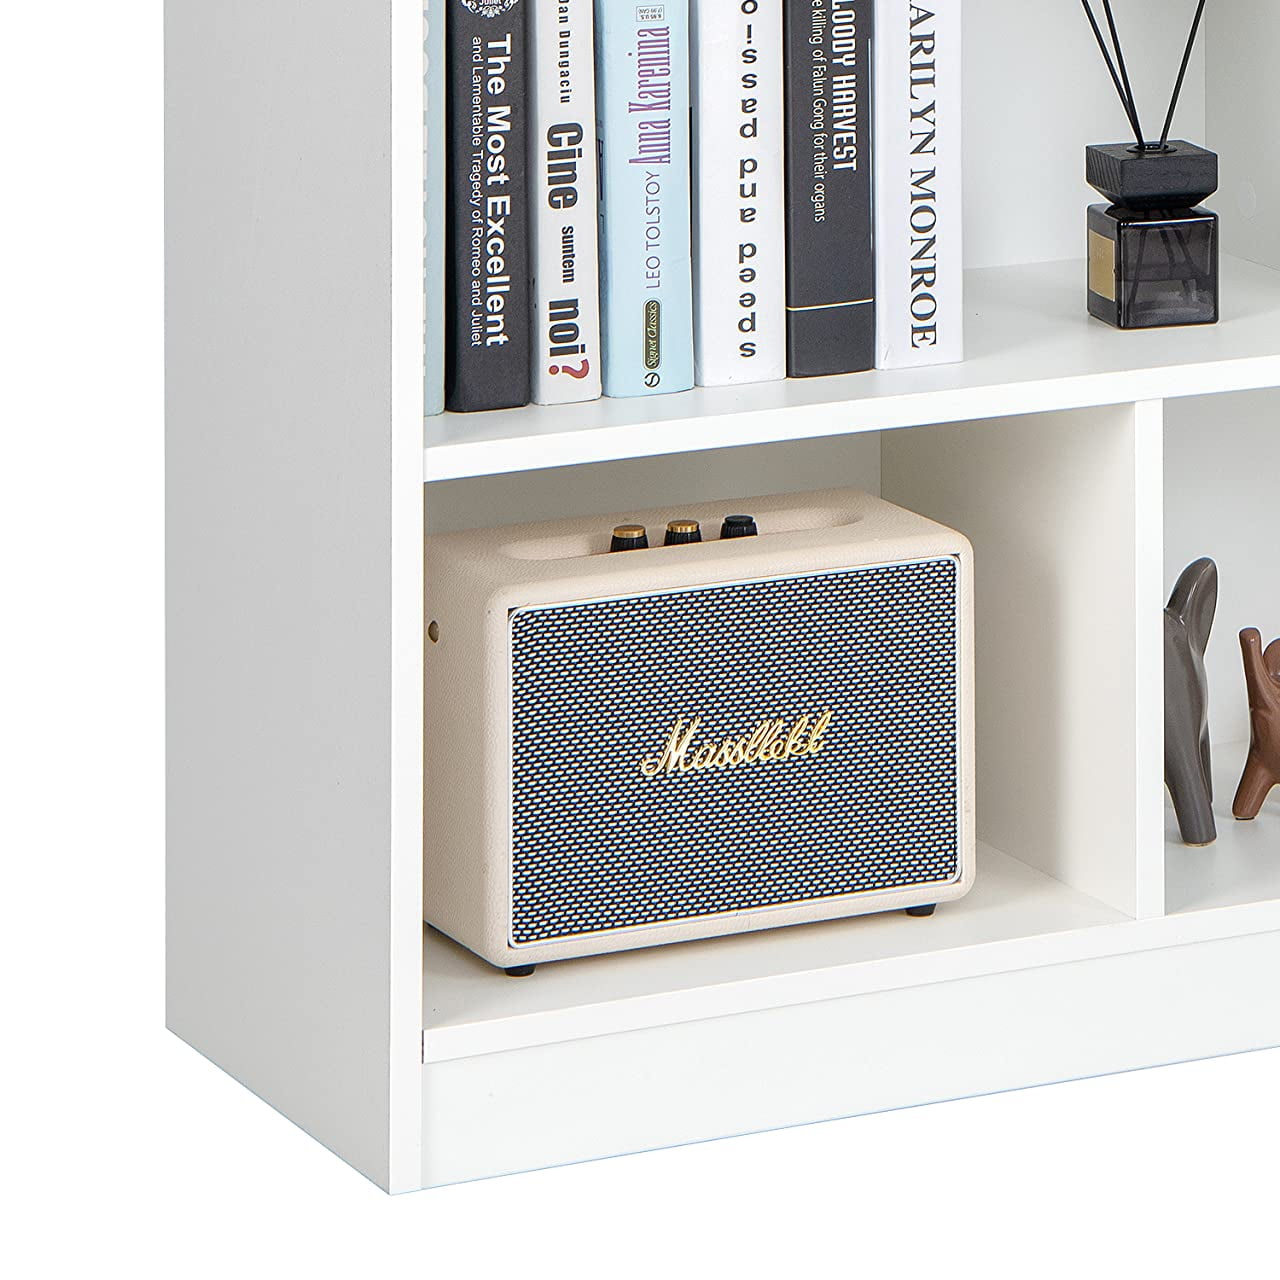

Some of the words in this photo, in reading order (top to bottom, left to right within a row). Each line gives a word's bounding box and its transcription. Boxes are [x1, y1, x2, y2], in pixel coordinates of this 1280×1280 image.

[472, 36, 484, 63] and
[808, 8, 827, 45] killing
[487, 33, 512, 95] The
[558, 30, 572, 104] Dungaciu
[628, 26, 672, 114] Karenina
[812, 49, 827, 62] of
[812, 65, 827, 96] Falun
[472, 66, 484, 146] Lamentable
[810, 98, 827, 130] Gong
[832, 74, 857, 171] HARVEST
[487, 105, 511, 186] Most
[628, 118, 672, 164] Anna
[813, 133, 828, 150] for
[469, 150, 484, 207] Tragedy
[546, 122, 584, 210] Cine
[813, 151, 828, 180] their
[645, 170, 661, 251] TOLSTOY
[739, 157, 758, 224] and
[811, 183, 825, 223] organs
[471, 209, 483, 224] of
[471, 227, 483, 277] Romeo
[486, 195, 511, 347] Excellent
[561, 225, 576, 284] suntem
[645, 255, 661, 289] LEO
[909, 168, 938, 349] MONROE
[471, 279, 482, 306] and
[471, 309, 483, 347] Juliet
[548, 298, 590, 380] noi?
[646, 301, 658, 338] Classics
[646, 339, 659, 368] Signet
